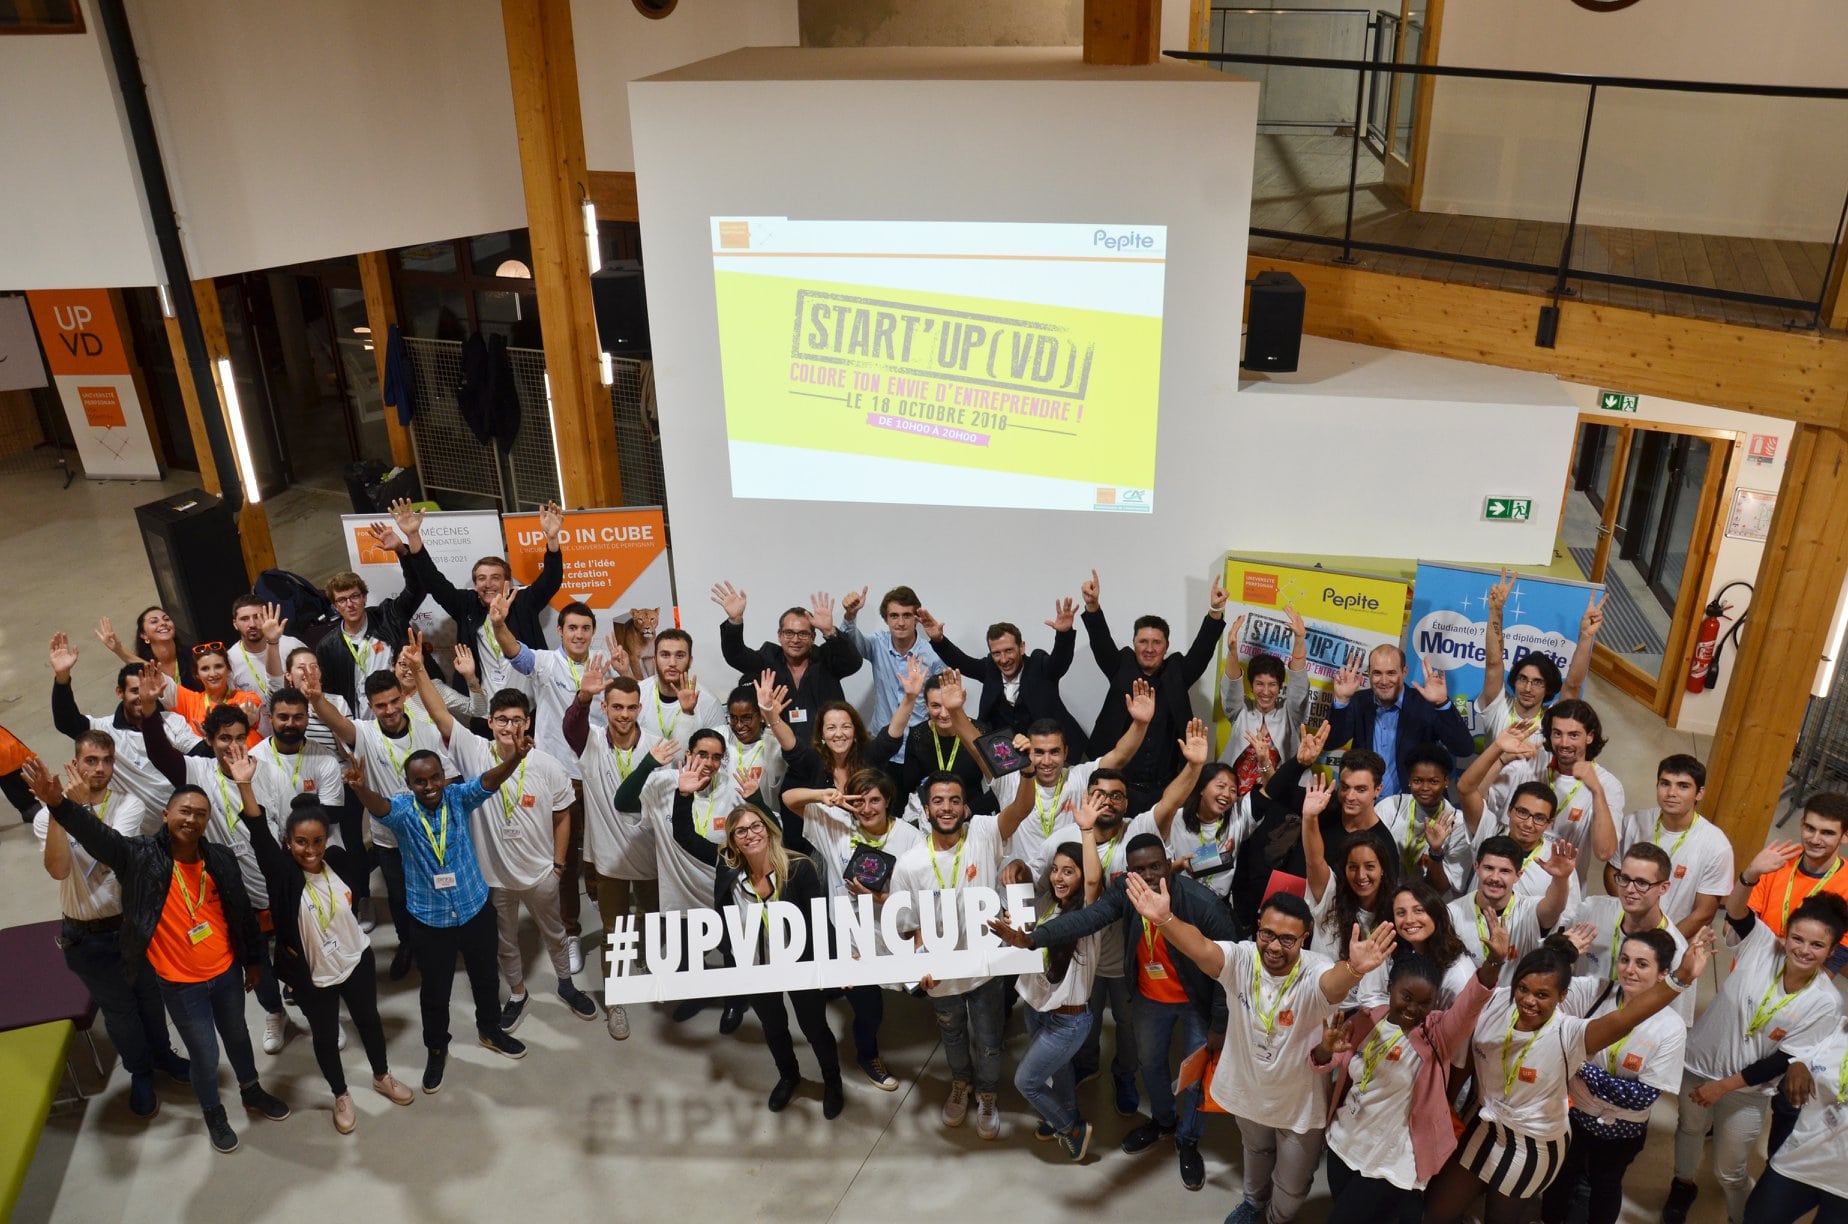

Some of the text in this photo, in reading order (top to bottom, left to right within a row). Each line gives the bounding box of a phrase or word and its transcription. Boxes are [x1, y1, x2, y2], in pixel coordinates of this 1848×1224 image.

[1093, 229, 1154, 251] Pepite
[53, 305, 92, 331] UP
[59, 332, 103, 357] VD
[790, 362, 846, 388] COLORE
[854, 371, 880, 392] TON
[887, 376, 929, 401] ENVIE
[935, 383, 1071, 422] D'ENTREPRENDRE
[846, 392, 1008, 431] LE 18 OCTOBRE 2018
[878, 416, 893, 427] DE
[896, 419, 930, 434] 10H00
[943, 428, 977, 443] 20H00
[421, 526, 470, 537] MÉCÈNES
[517, 525, 654, 546] UPD IN CUBE
[568, 569, 609, 579] création
[574, 559, 586, 568] de
[588, 558, 616, 567] l'idée
[1322, 587, 1379, 610] Pepite
[1432, 620, 1485, 636] Étudiant(e) ?
[1420, 630, 1486, 662] Monte
[1512, 633, 1558, 648] diplômé(e)
[1560, 639, 1566, 648] ?
[605, 883, 1035, 977] #UPVDINCUBE
